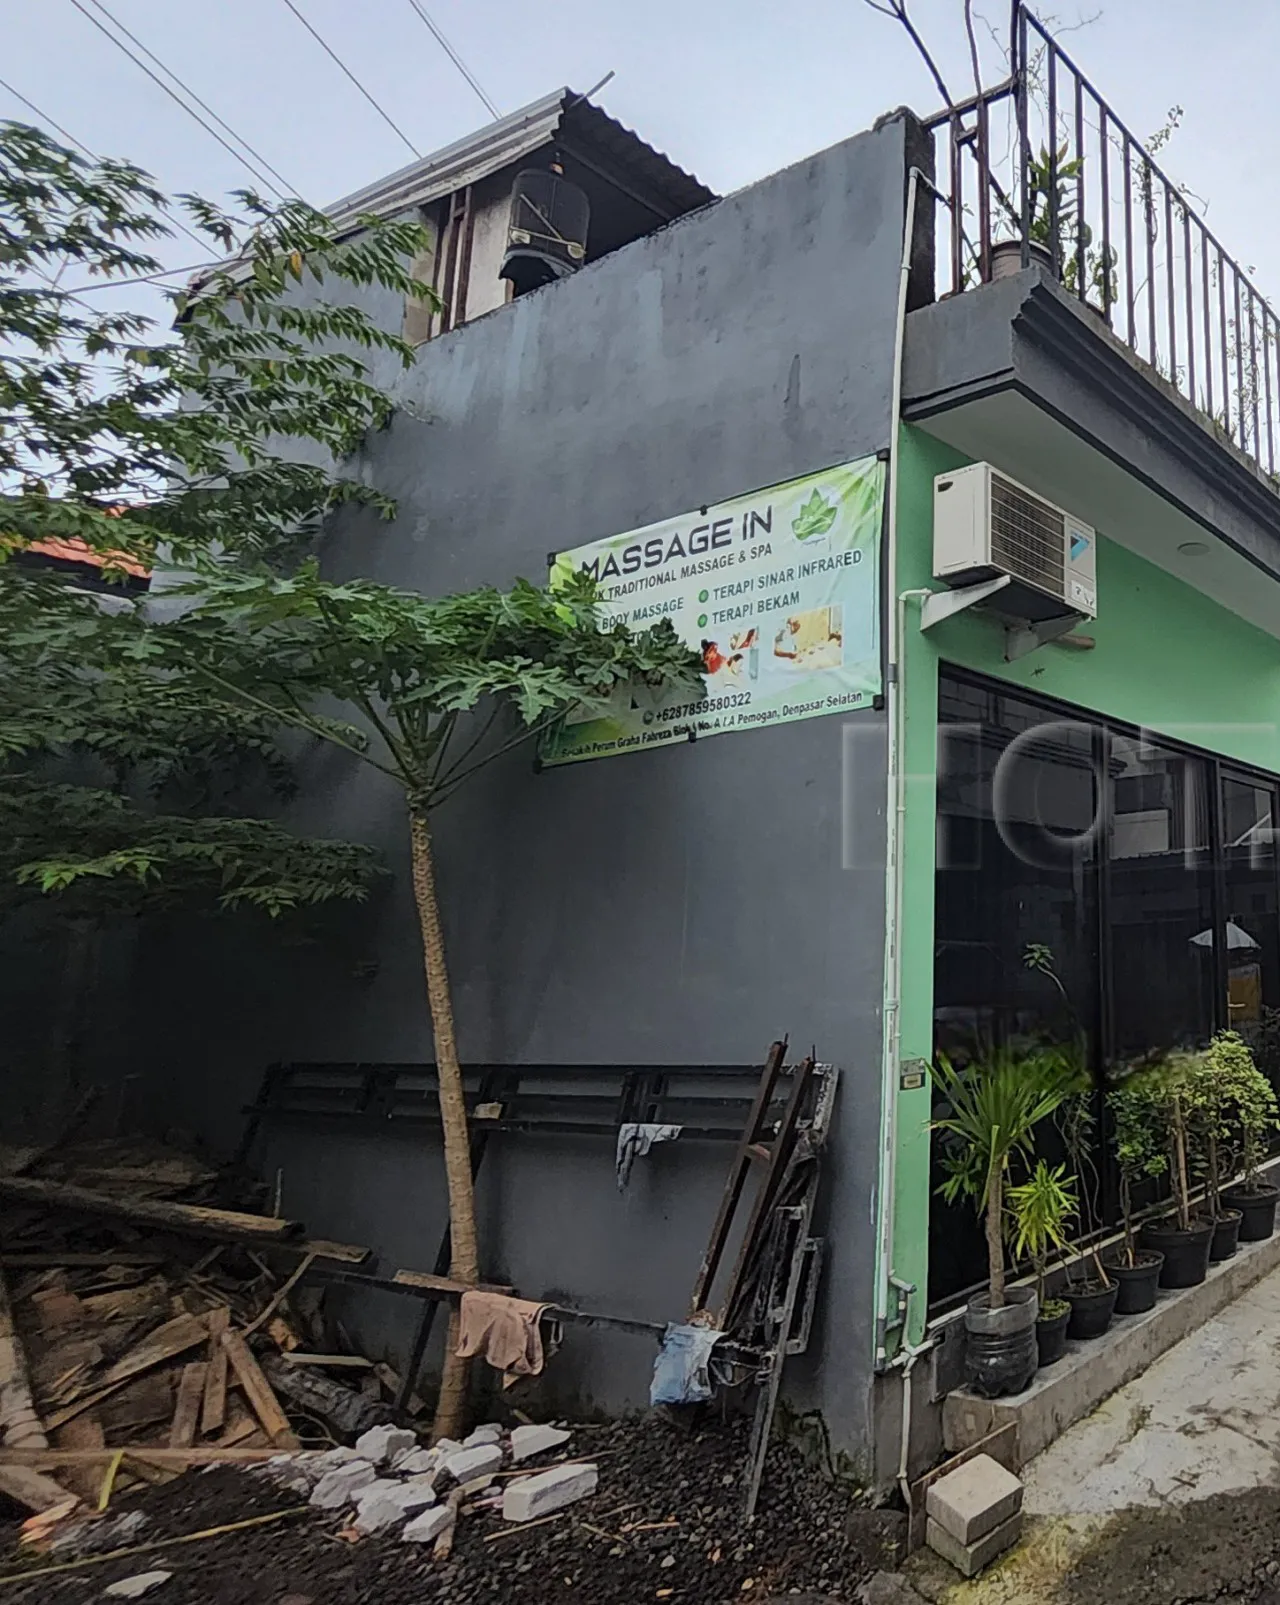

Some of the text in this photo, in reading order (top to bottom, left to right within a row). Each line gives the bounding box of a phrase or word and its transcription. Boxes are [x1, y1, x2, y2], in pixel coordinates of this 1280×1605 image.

[582, 505, 772, 582] MASSAGE IN
[608, 569, 677, 600] TRADITIONAL
[681, 552, 735, 580] MASSAGE
[738, 549, 746, 564] &
[750, 542, 772, 560] SPA
[713, 549, 862, 600] TERAPI SINAR INFRARED
[633, 597, 684, 622] MASSAGE
[712, 591, 800, 625] TERAPI BEKAM
[655, 692, 752, 723] +6287859580322
[738, 709, 780, 725] Pemogan,
[782, 699, 825, 716] Denpasar
[826, 692, 862, 708] Selatan
